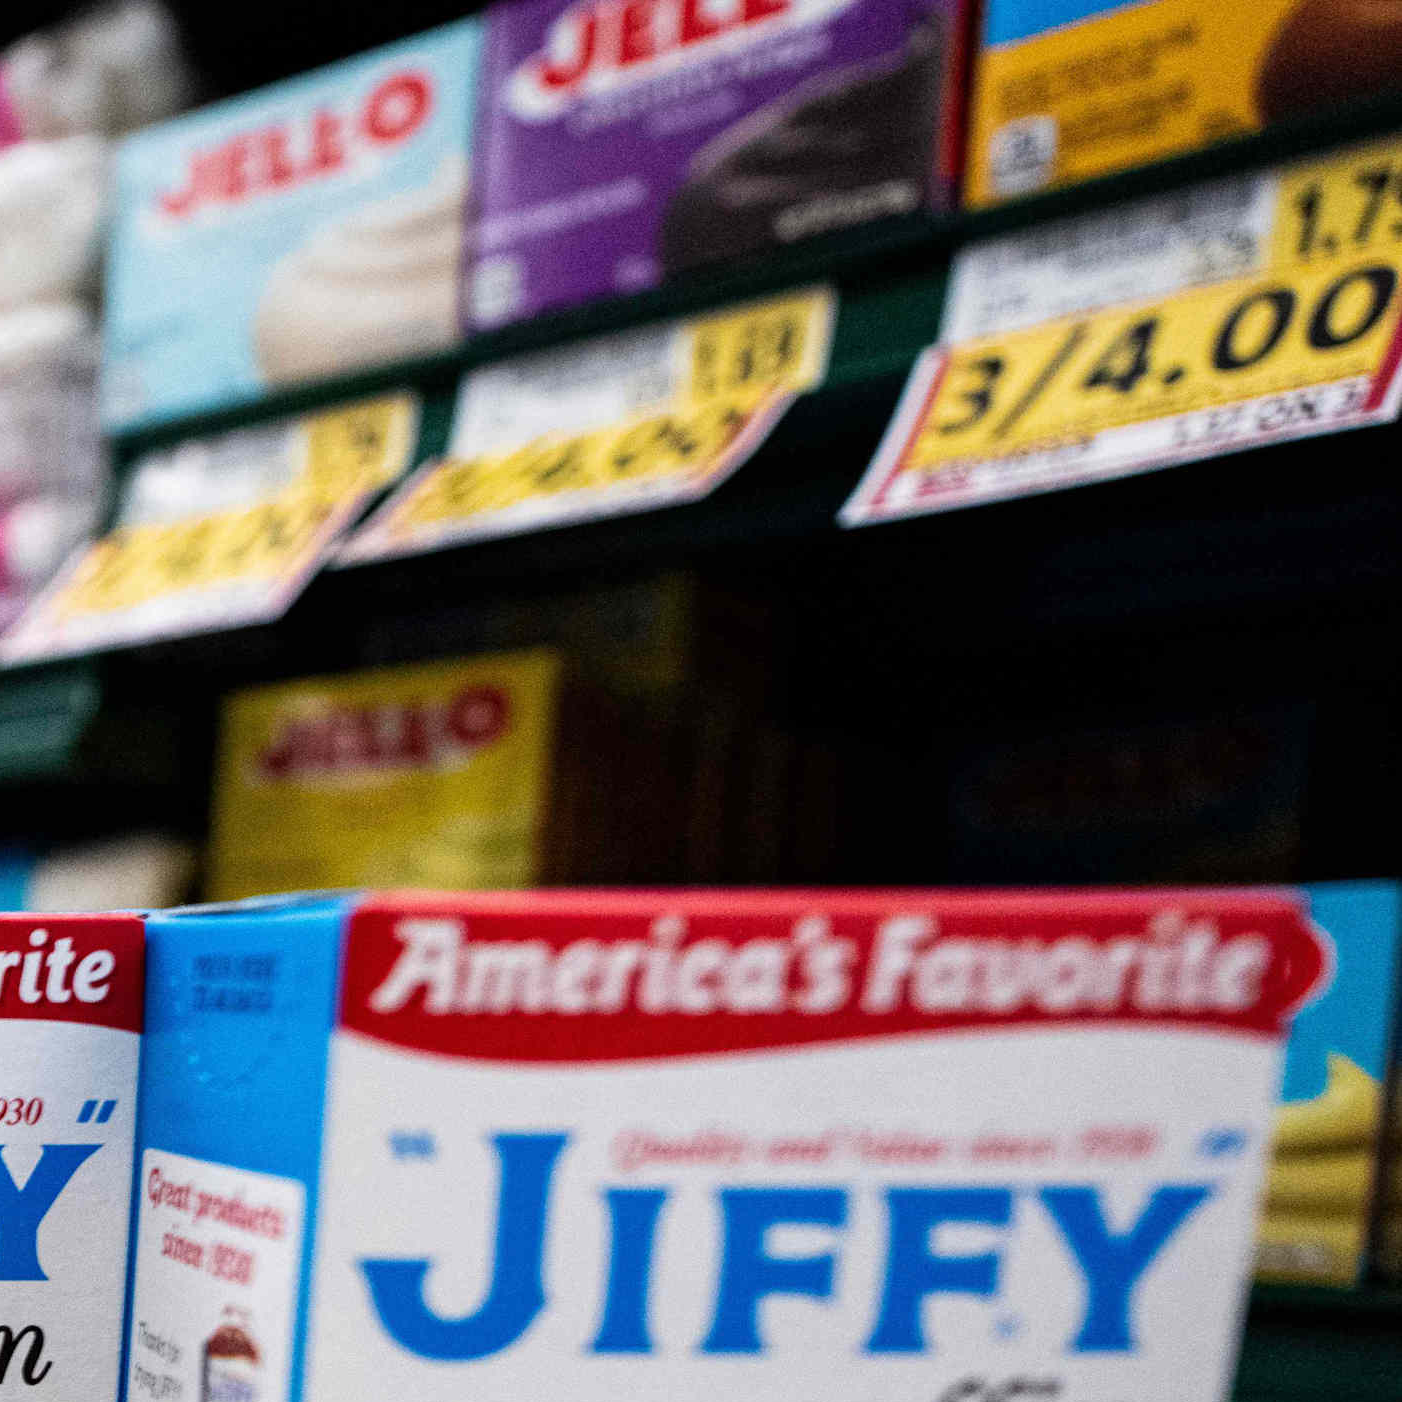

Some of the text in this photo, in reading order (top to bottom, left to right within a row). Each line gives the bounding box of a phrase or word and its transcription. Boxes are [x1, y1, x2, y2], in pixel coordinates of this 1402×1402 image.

[937, 264, 1400, 442] 3/4.00
[367, 908, 1276, 1018] America's Favorite
